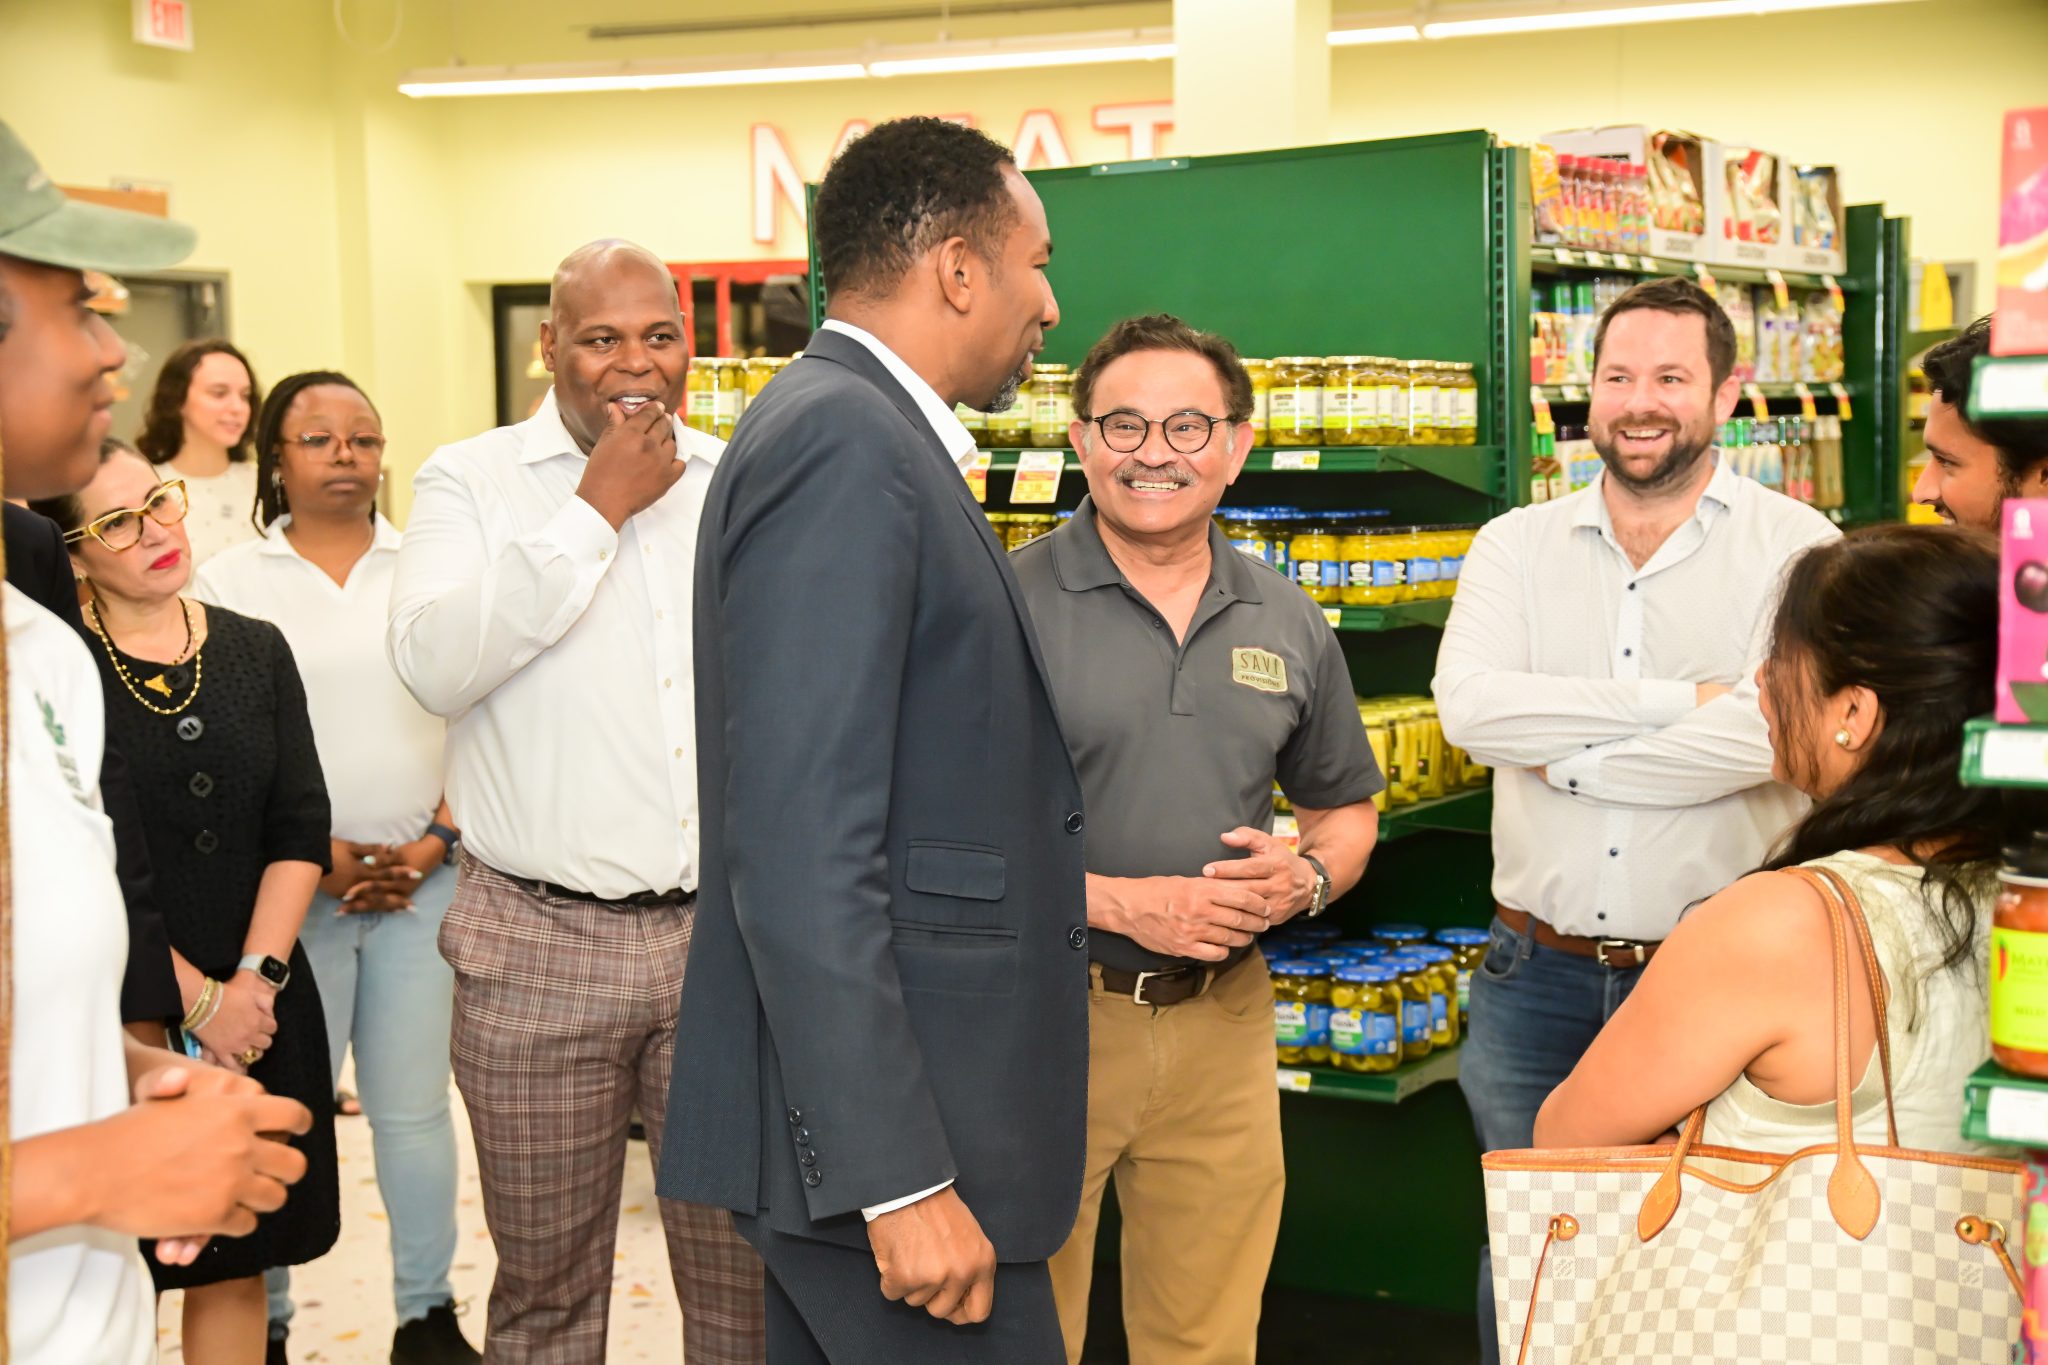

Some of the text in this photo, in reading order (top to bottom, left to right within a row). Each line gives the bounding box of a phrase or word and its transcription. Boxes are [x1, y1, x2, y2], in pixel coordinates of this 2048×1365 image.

[149, 0, 185, 41] EXIT
[751, 100, 1174, 244] MAT
[1240, 653, 1279, 676] SAVI
[1241, 674, 1280, 688] PROVISIONS
